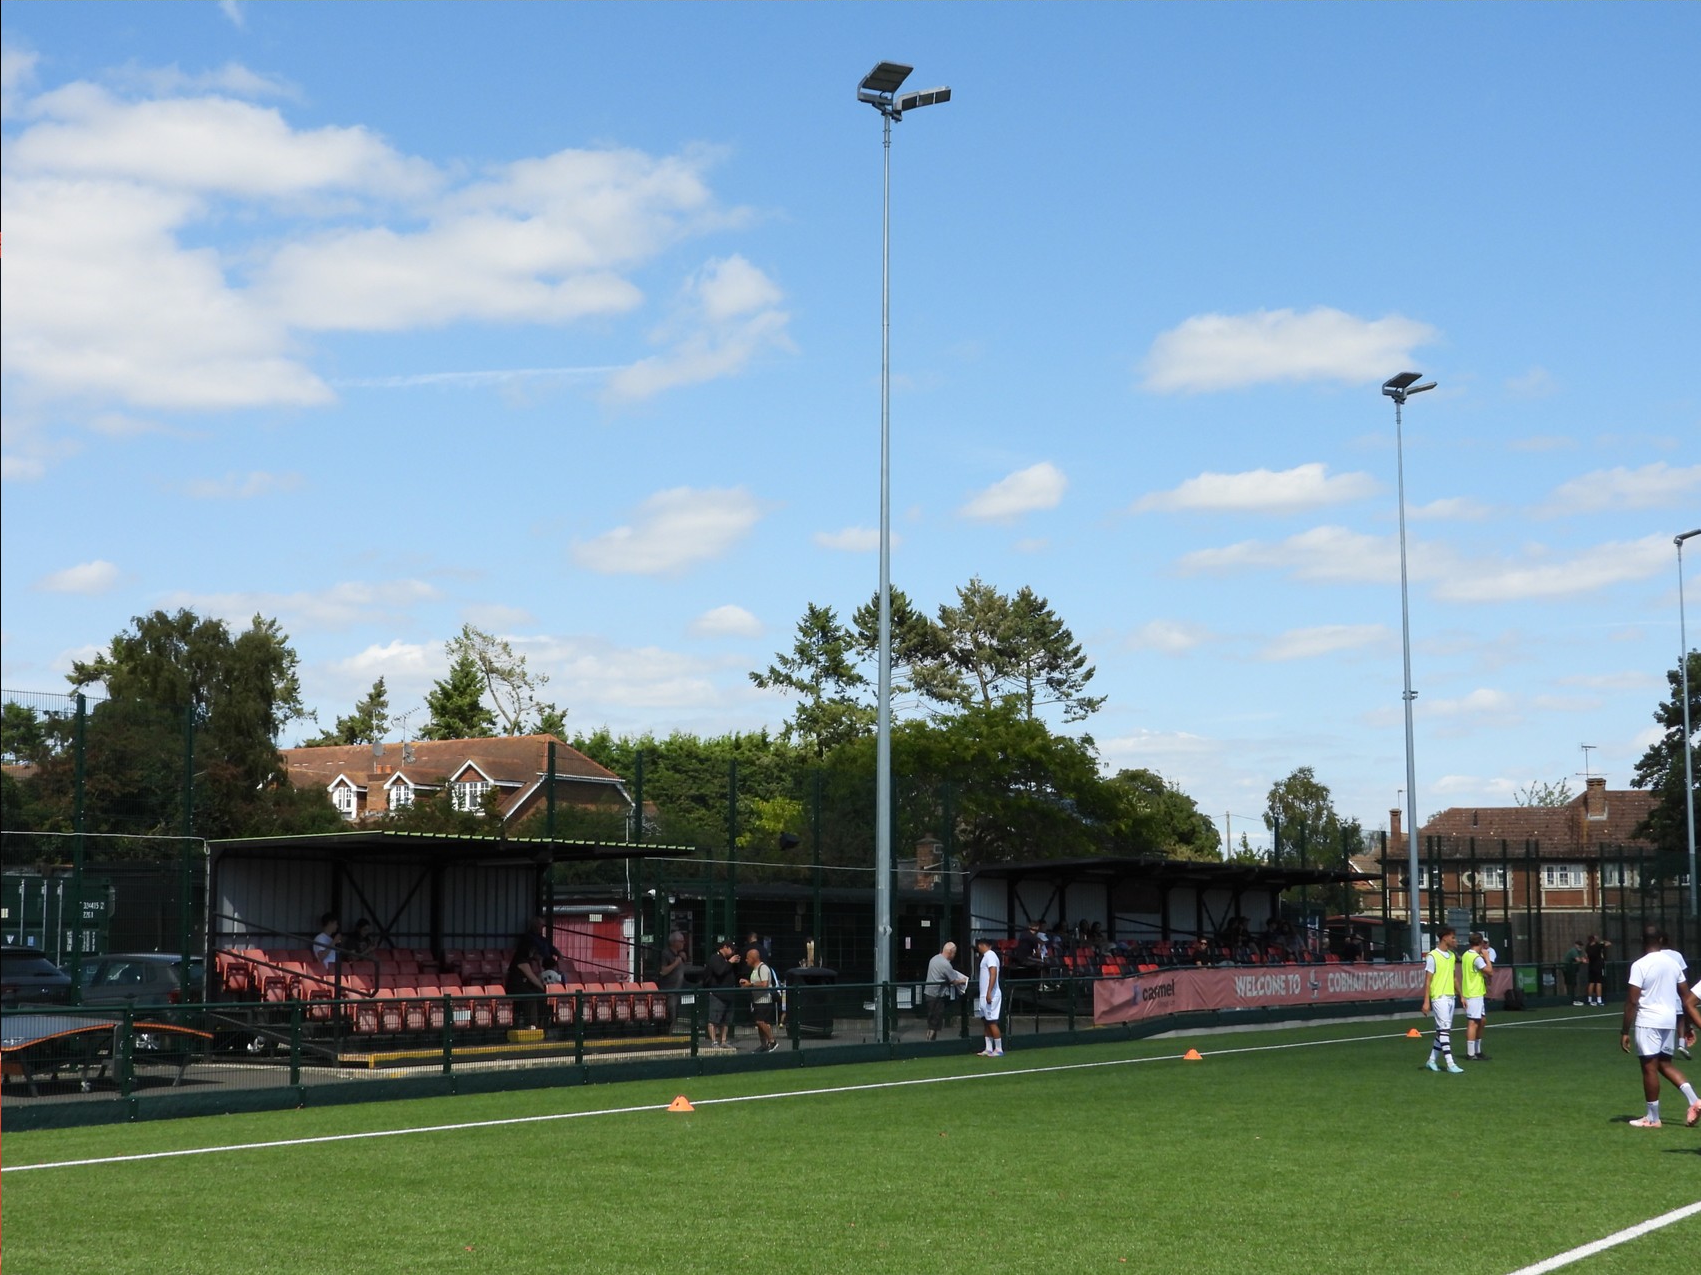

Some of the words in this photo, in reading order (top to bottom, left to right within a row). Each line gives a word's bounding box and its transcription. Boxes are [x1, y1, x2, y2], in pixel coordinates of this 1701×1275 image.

[1142, 978, 1175, 1002] carmel
[1235, 974, 1286, 998] WELCOME
[1287, 973, 1301, 995] TO
[1327, 971, 1367, 993] COBHAM
[1367, 970, 1408, 992] FOOTBALL
